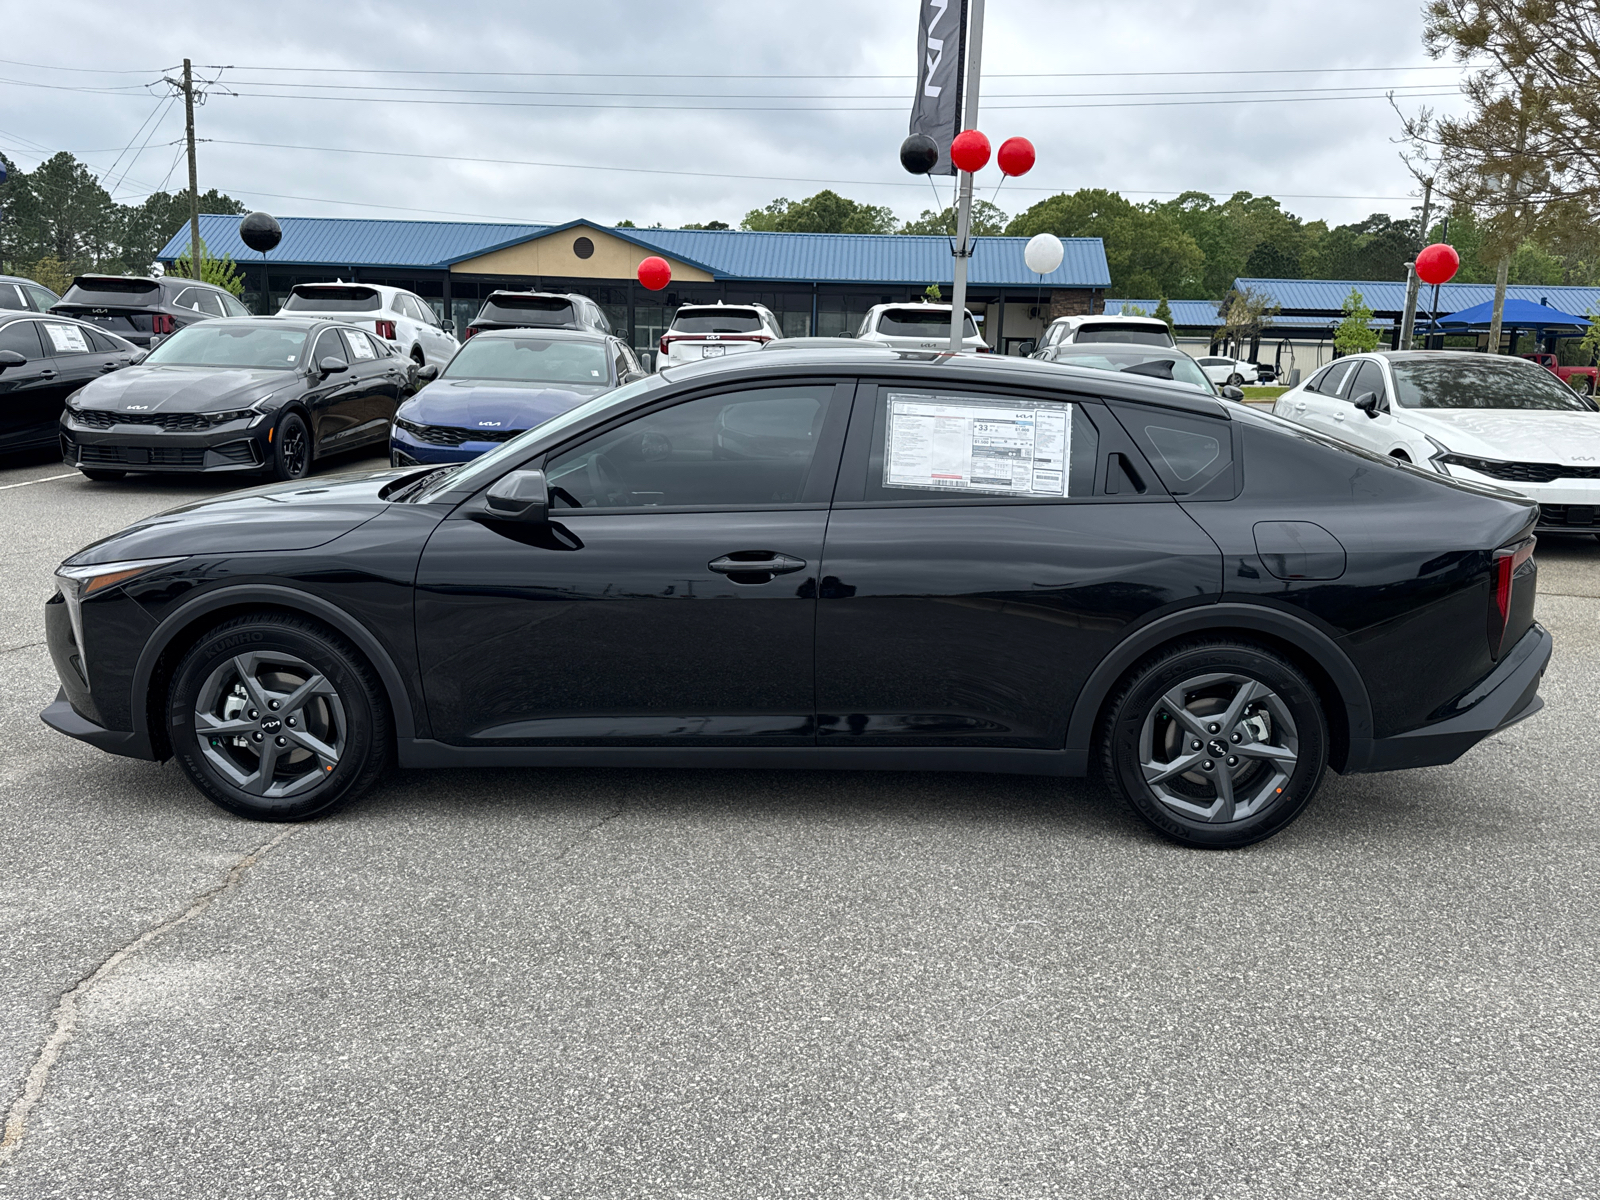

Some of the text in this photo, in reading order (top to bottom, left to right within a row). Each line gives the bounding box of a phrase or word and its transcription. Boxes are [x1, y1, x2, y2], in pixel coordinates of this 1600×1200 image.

[204, 632, 263, 659] KUMHO
[261, 720, 281, 730] KIA
[1209, 740, 1227, 756] KIA
[1137, 797, 1191, 837] KUMHO
